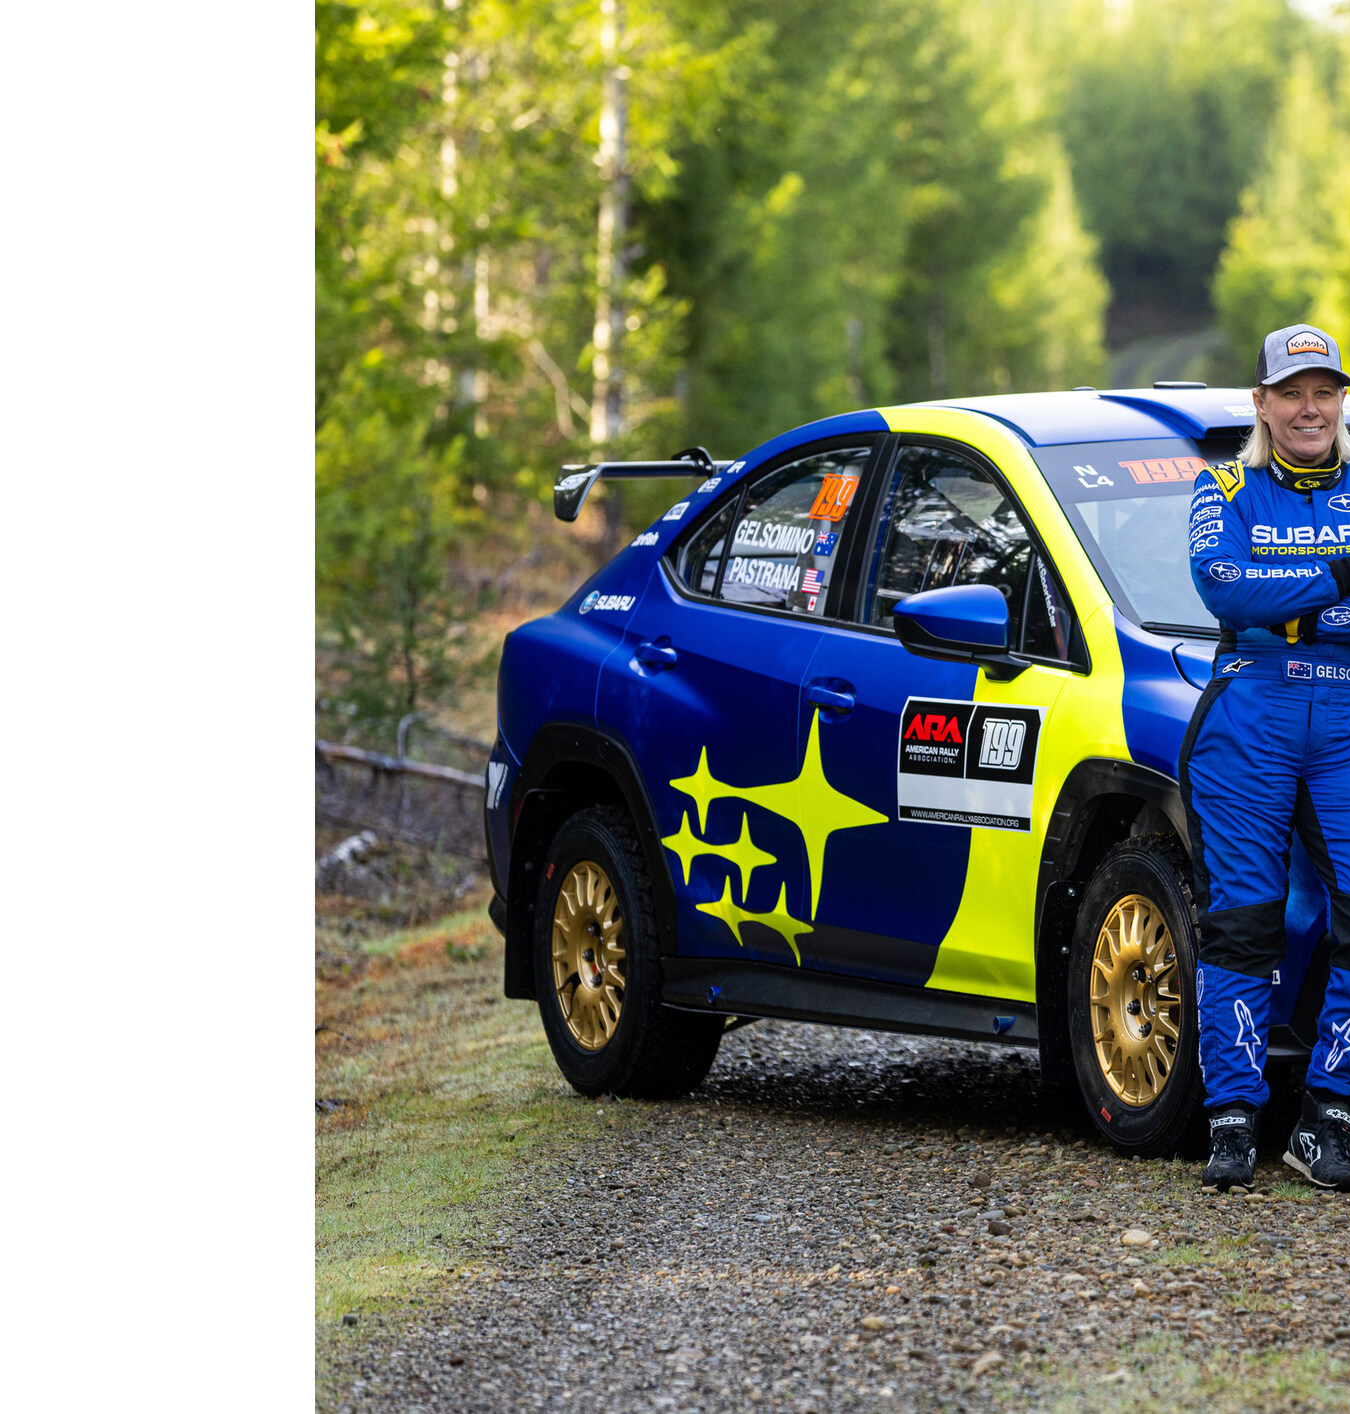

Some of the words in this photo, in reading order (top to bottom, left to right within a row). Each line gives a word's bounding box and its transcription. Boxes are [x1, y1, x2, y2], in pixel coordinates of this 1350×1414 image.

[1290, 339, 1326, 350] Kubota
[1072, 464, 1099, 477] N
[1117, 456, 1209, 485] 199
[1078, 475, 1115, 489] L4
[807, 473, 860, 522] 199
[734, 519, 815, 554] GELSOMINO
[1191, 523, 1220, 540] OTUL
[728, 556, 801, 592] PASTRANA
[1245, 566, 1321, 579] SUBARU
[594, 595, 636, 611] SUBARU
[903, 713, 963, 743] ARA
[905, 744, 938, 755] AMERICAN
[939, 746, 960, 757] RALLY
[978, 717, 1027, 771] 199
[909, 754, 953, 764] ASSOCIATION
